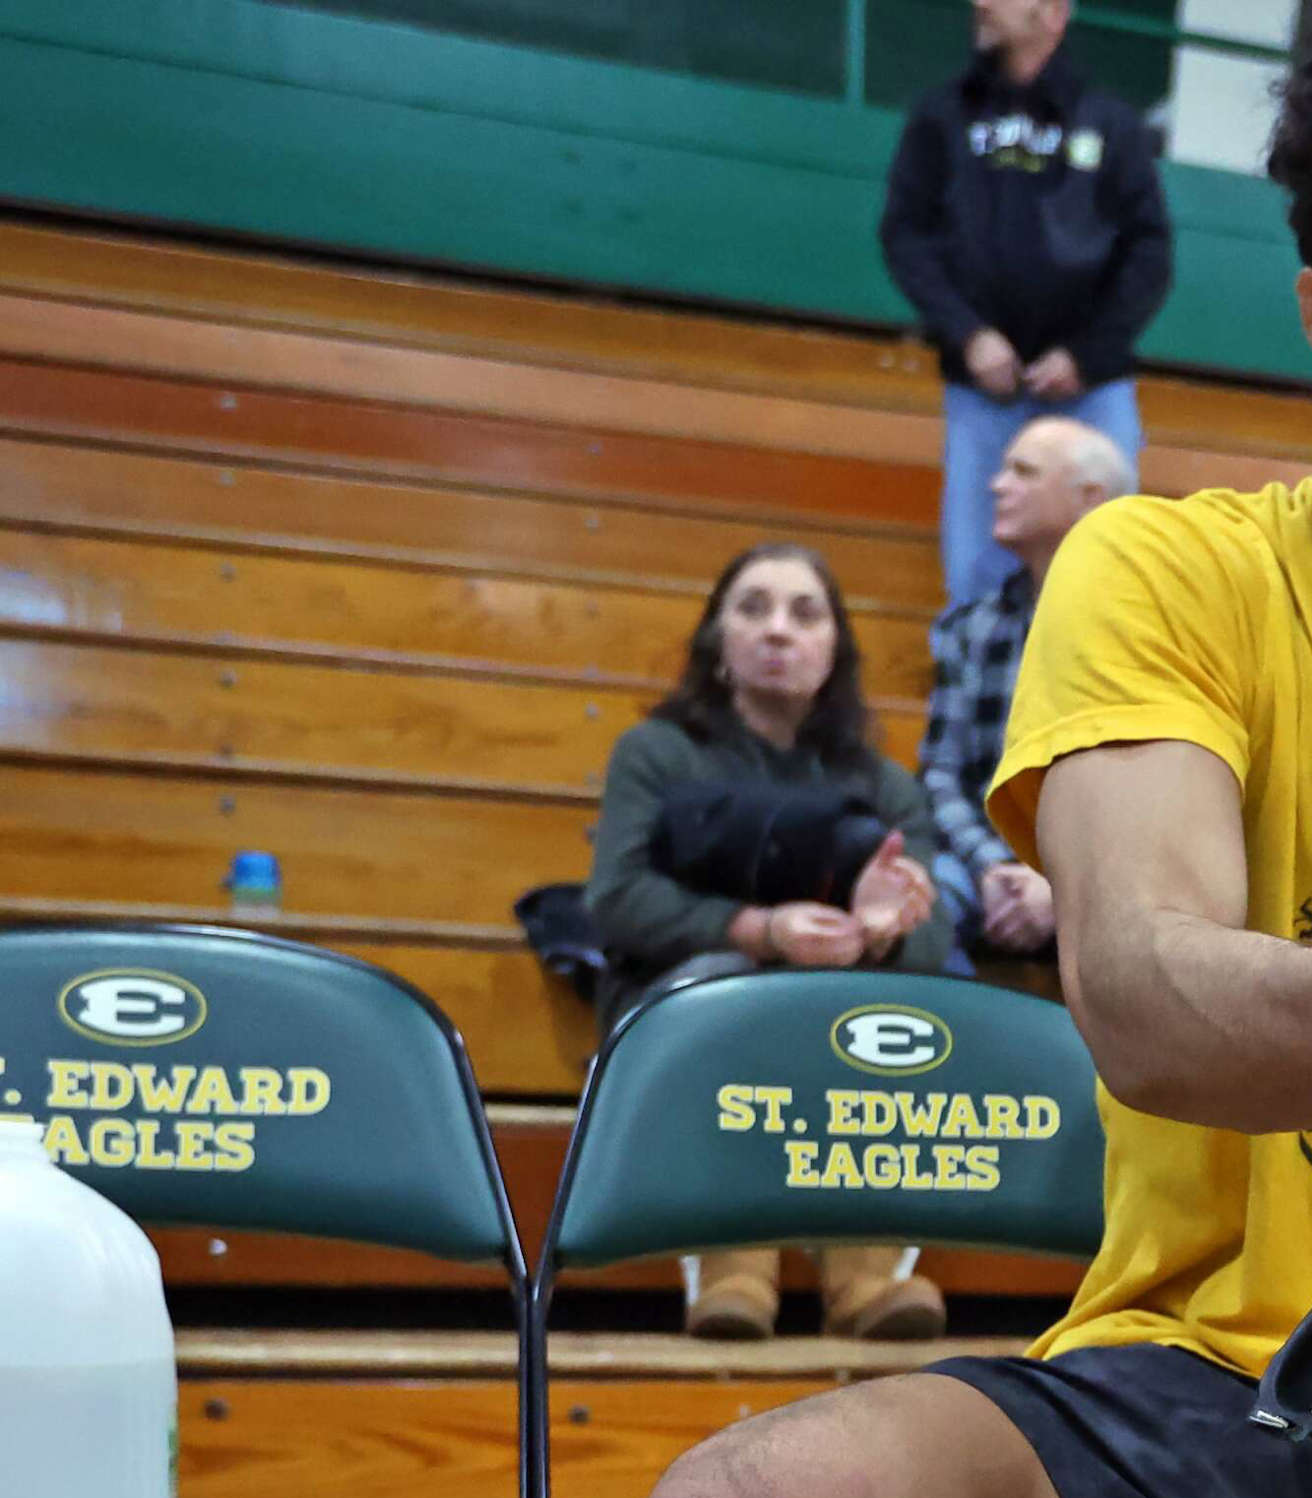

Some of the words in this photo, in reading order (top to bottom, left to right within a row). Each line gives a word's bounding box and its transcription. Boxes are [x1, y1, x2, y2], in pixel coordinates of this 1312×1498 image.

[46, 1059, 332, 1116] EDWARD
[717, 1083, 808, 1135] ST.
[826, 1088, 1061, 1139] EDWARD
[0, 1112, 256, 1172] AGLES
[784, 1140, 1001, 1191] EAGLES
